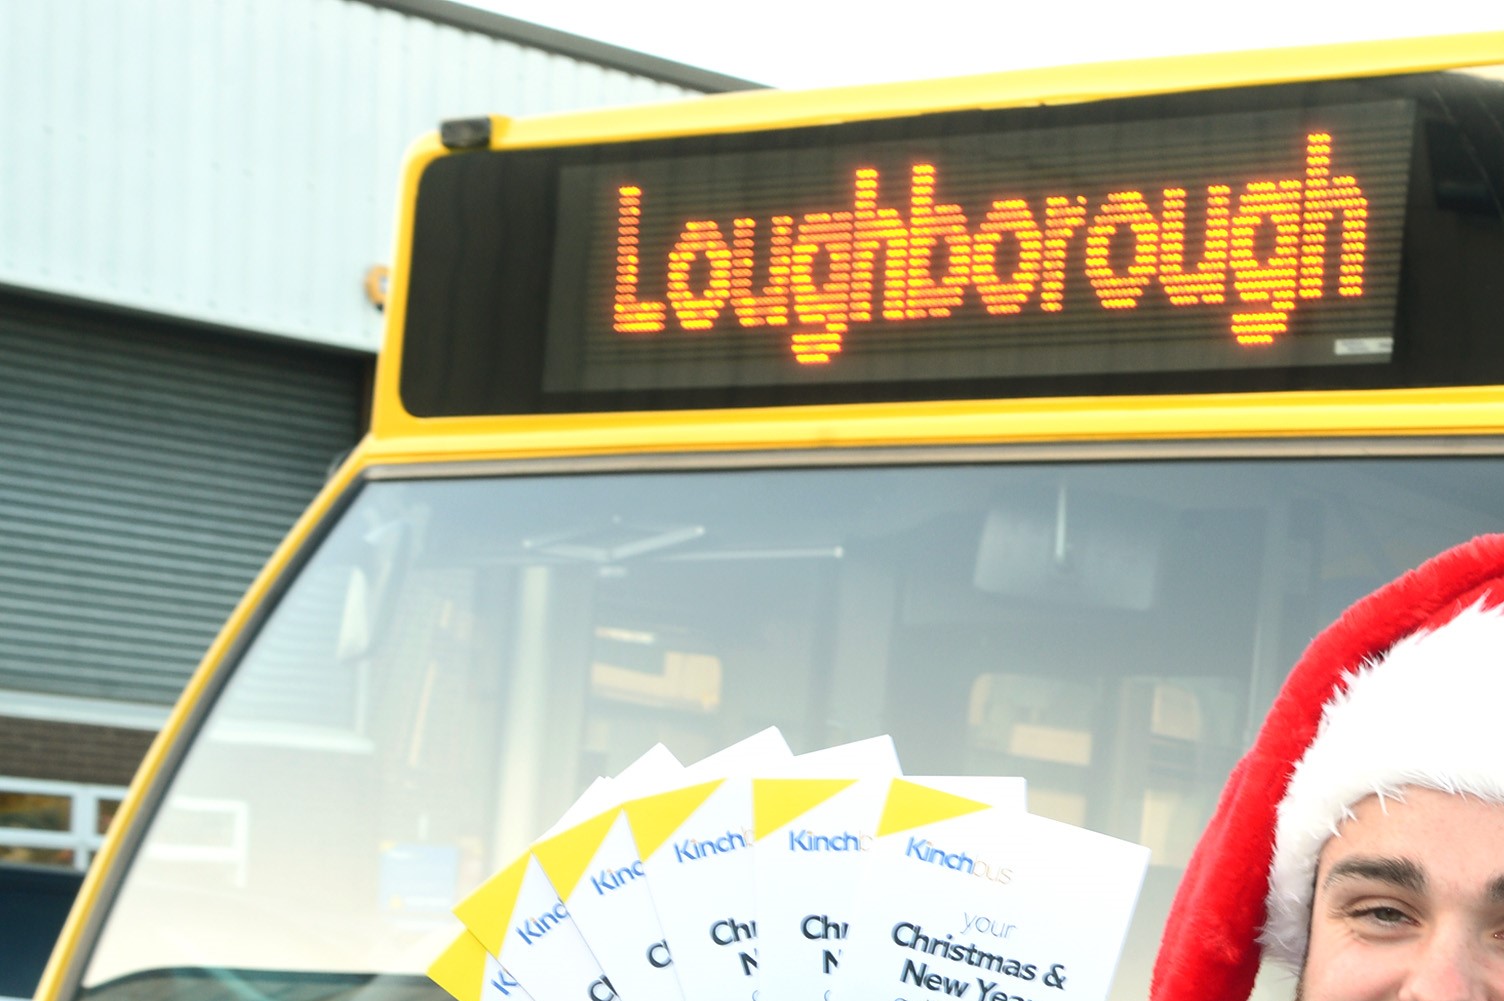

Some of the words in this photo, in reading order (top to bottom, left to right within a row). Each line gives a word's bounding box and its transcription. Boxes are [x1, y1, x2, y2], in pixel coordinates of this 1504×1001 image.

[613, 132, 1368, 364] Loughborough
[590, 859, 646, 896] Kinc
[905, 835, 1015, 885] Kinchbus
[515, 896, 570, 945] Kinc
[959, 911, 1017, 939] your
[891, 920, 1038, 982] Christmas
[1041, 962, 1069, 991] &
[899, 957, 970, 999] New
